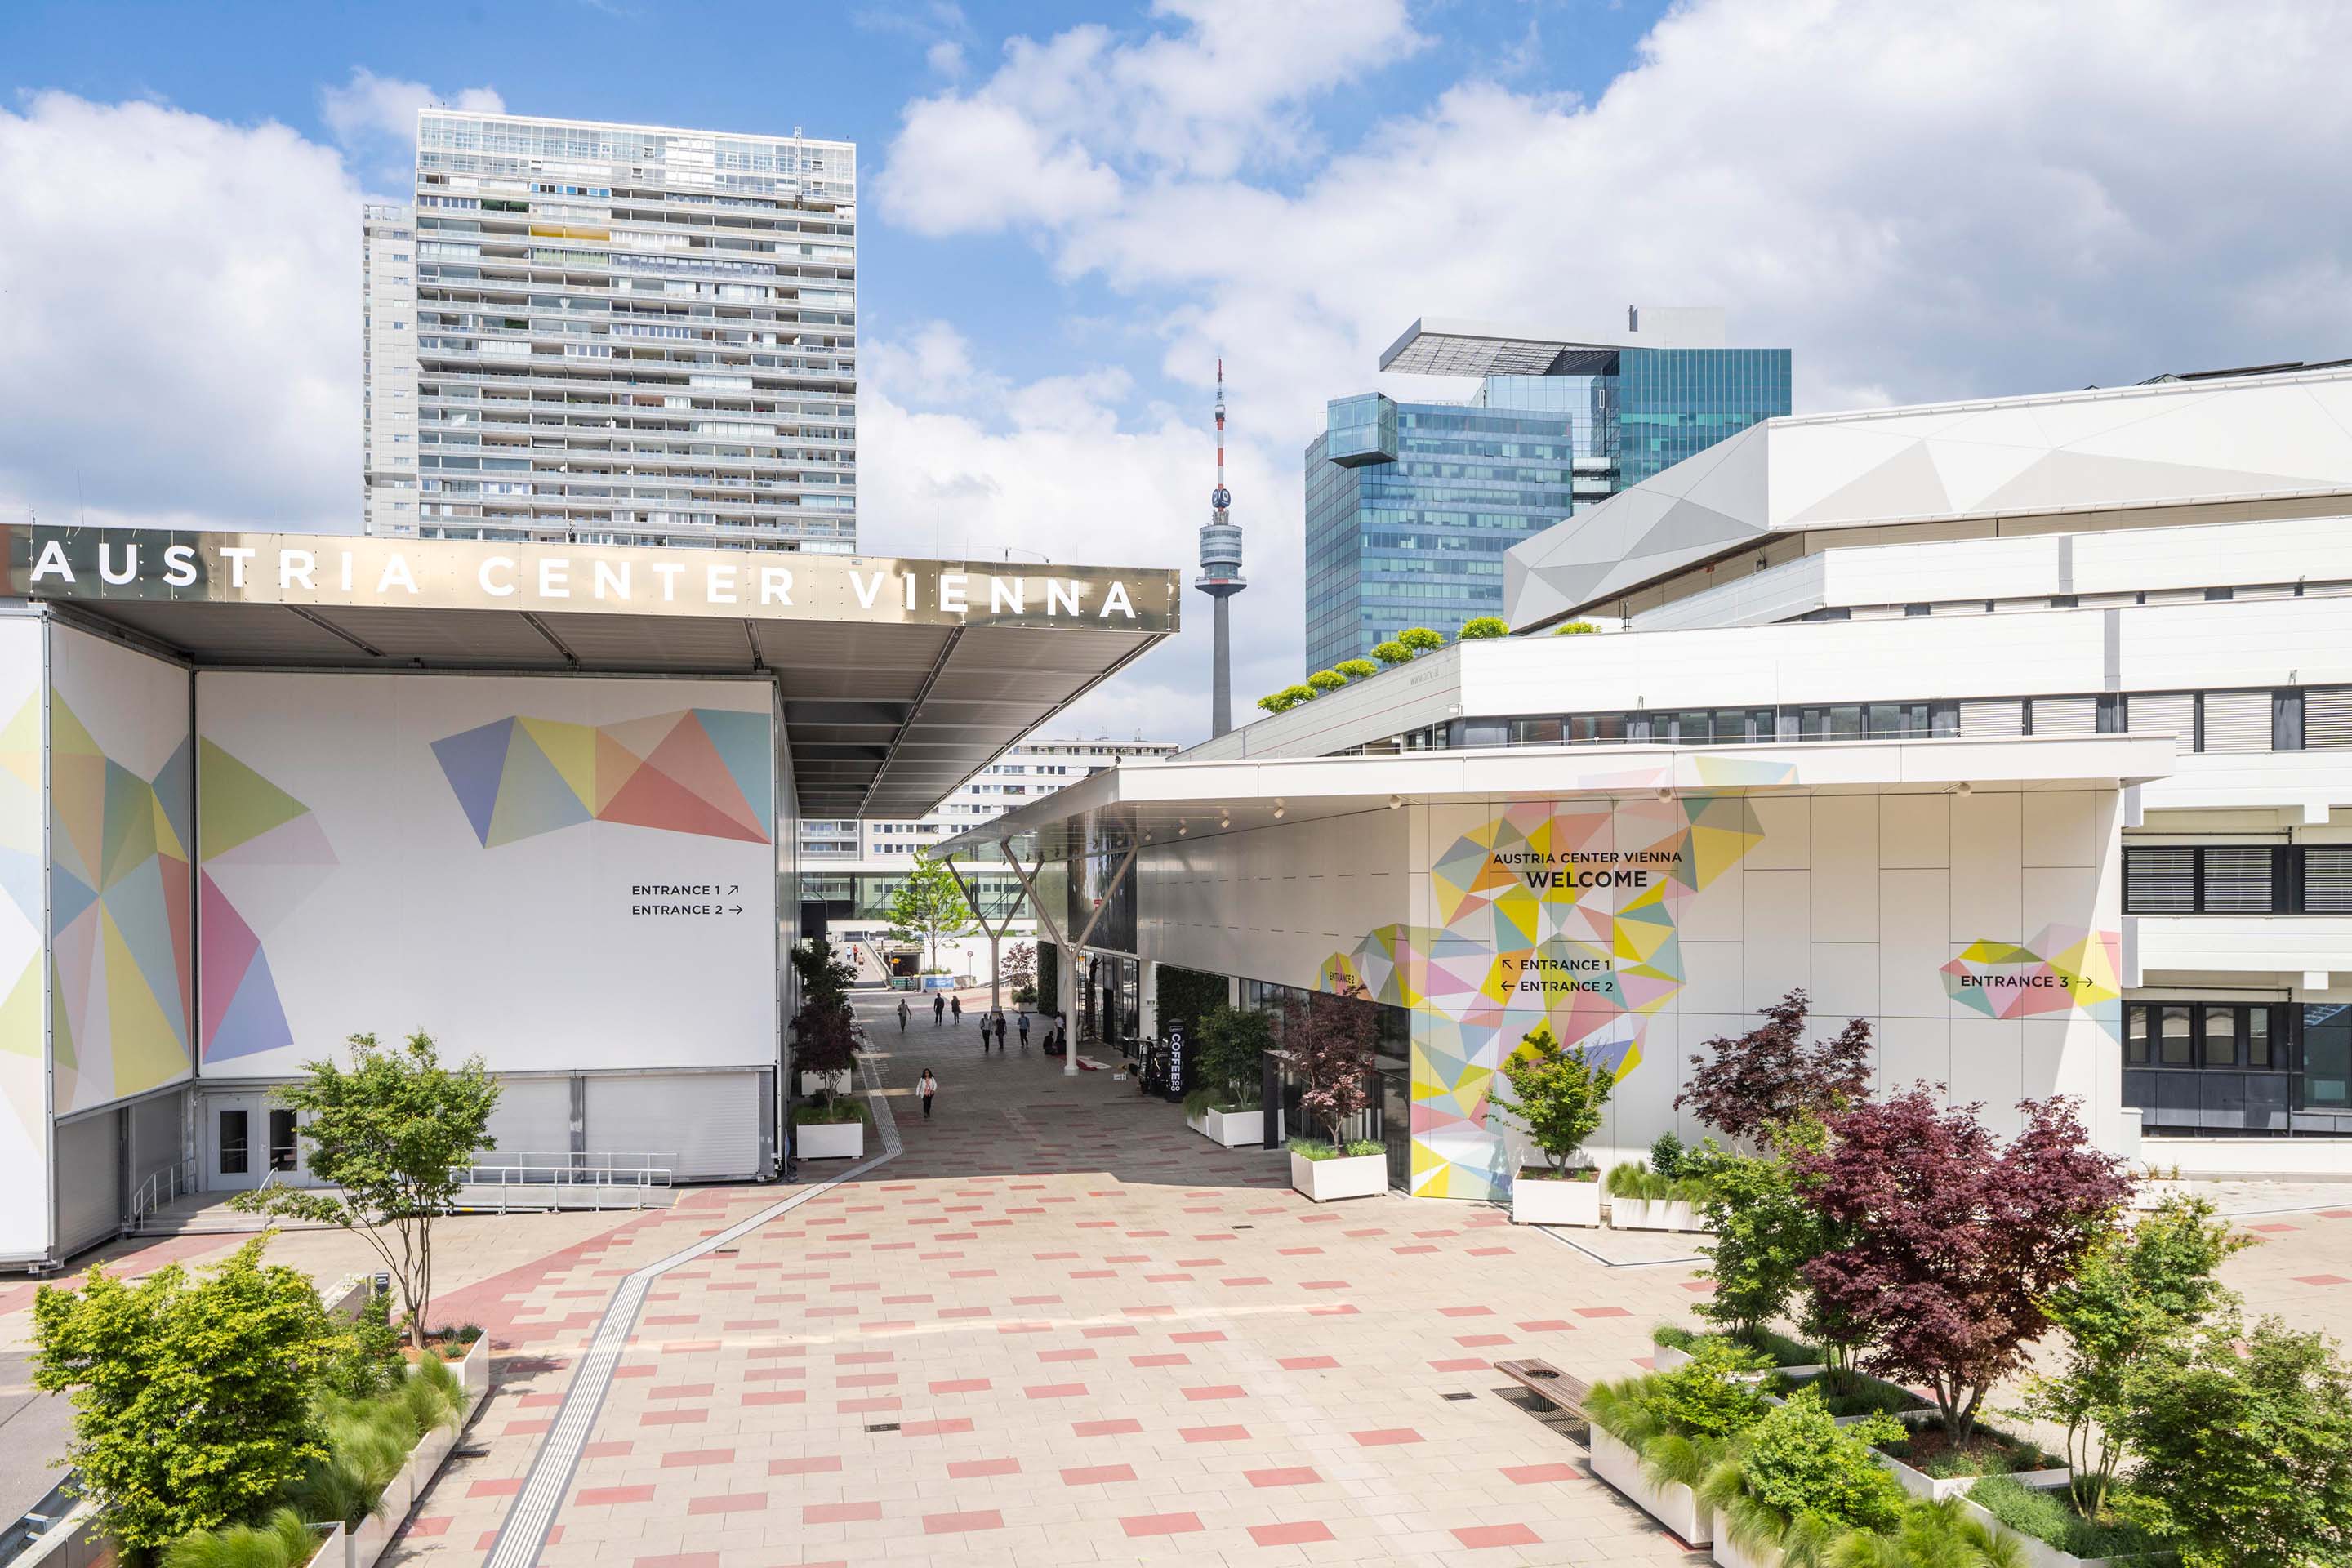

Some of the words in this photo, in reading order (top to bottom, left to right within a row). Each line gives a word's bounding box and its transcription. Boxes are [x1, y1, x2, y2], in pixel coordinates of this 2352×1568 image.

[30, 540, 418, 594] AUSTRIA
[479, 556, 794, 605] CENTER
[848, 570, 1136, 619] VIENNA
[1493, 853, 1556, 864] AUSTRIA
[1561, 852, 1619, 863] CENTER
[1624, 852, 1682, 863] VIENNA
[1526, 871, 1648, 888] WELCOME
[632, 885, 710, 895] ENTRANCE
[715, 885, 719, 895] 1
[632, 905, 710, 915] ENTRANCE
[715, 905, 723, 915] 2
[1521, 960, 1601, 971] ENTRANCE
[1604, 960, 1610, 971] 1
[1521, 981, 1601, 992] ENTRANCE
[1605, 981, 1613, 992] 2
[1961, 975, 2054, 987] ENTRANCE
[2060, 976, 2069, 987] 3
[1171, 1033, 1181, 1080] COFFEE
